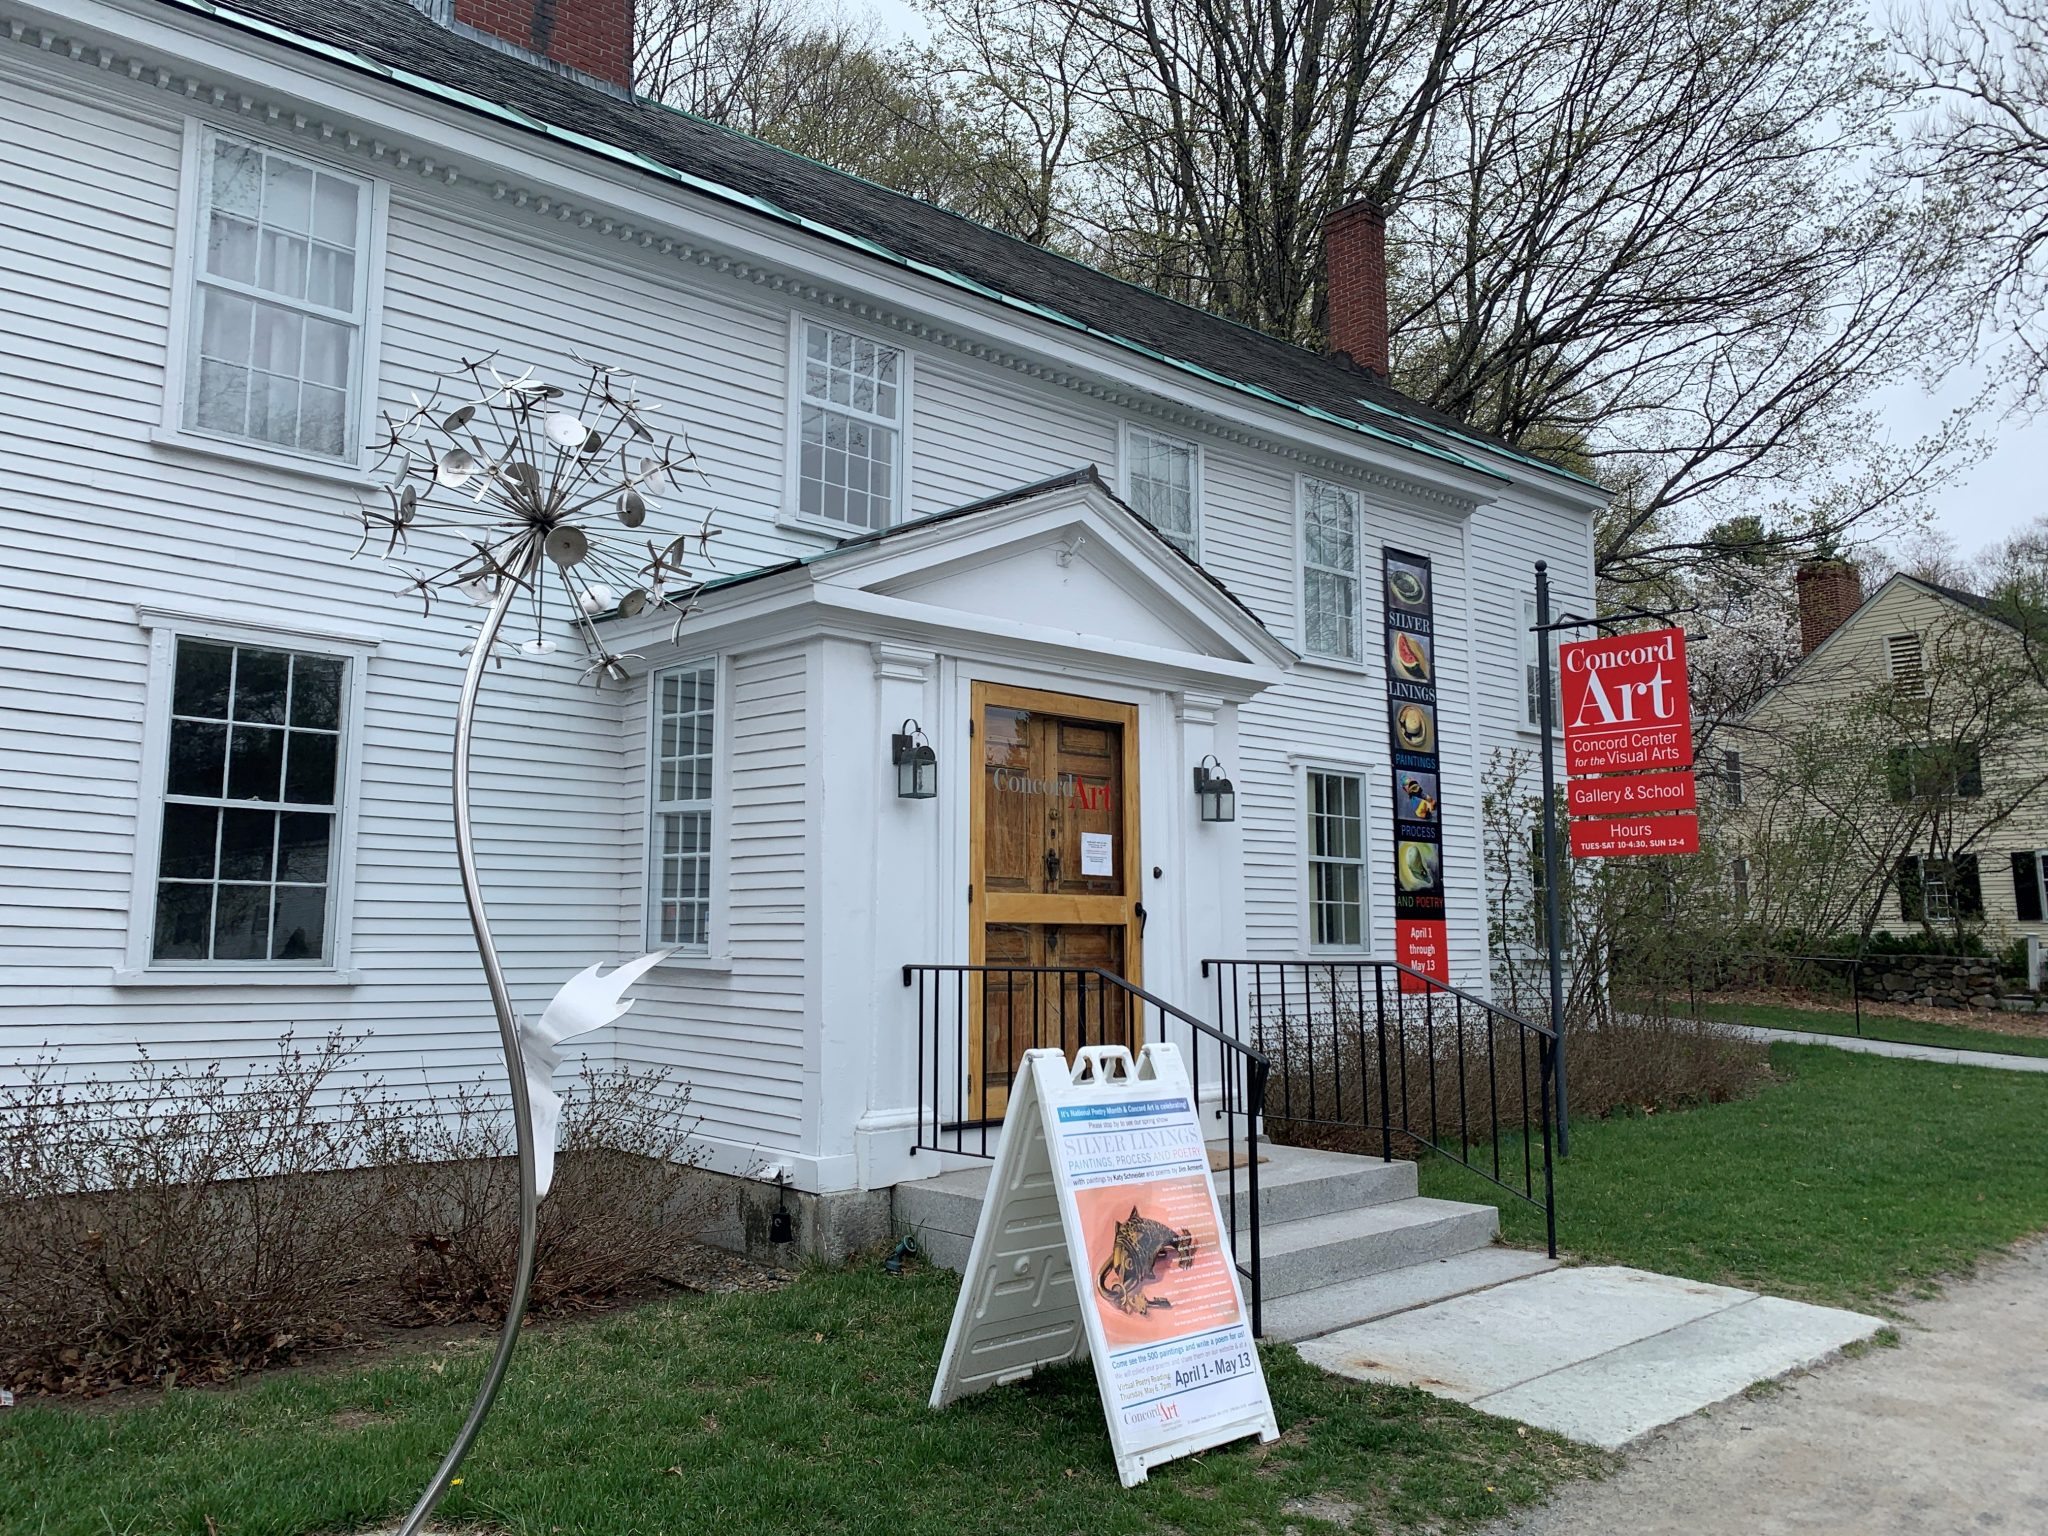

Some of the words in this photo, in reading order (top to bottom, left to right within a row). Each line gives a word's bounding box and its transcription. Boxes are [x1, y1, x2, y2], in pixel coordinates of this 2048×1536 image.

[1388, 612, 1430, 633] SILVER
[1566, 636, 1676, 672] Concord
[1388, 680, 1436, 702] LININGS
[1568, 663, 1675, 727] Art
[1573, 735, 1627, 753] Concord
[1631, 732, 1677, 747] Center
[1395, 753, 1436, 769] PAINTINGS
[1575, 758, 1588, 767] for
[1590, 756, 1606, 766] the
[1606, 748, 1648, 764] Visual
[1651, 747, 1680, 760] Arts
[1575, 789, 1621, 804] Gallery
[1624, 786, 1634, 800] &
[1637, 783, 1684, 799] School
[1401, 824, 1436, 839] PROCESS
[1610, 823, 1652, 837] Hours
[1581, 842, 1615, 850] TUES-SAT
[1618, 840, 1648, 849] 10-4:30,
[1650, 839, 1666, 847] SUN
[1668, 838, 1684, 846] 12-4
[1397, 896, 1414, 907] AND
[1416, 896, 1443, 909] POETRY
[1411, 927, 1427, 940] April
[1428, 927, 1432, 938] 1
[1409, 944, 1435, 957] through
[1411, 960, 1425, 973] May
[1427, 960, 1435, 971] 13
[1070, 1108, 1091, 1117] National
[1091, 1107, 1106, 1116] Poetry
[1106, 1106, 1122, 1114] Month
[1128, 1104, 1146, 1112] Concord
[1064, 1134, 1126, 1157] SILVER
[1129, 1127, 1198, 1150] LININGS
[1068, 1157, 1114, 1170] PAINTINGS,
[1115, 1152, 1151, 1165] PROCESS
[1153, 1150, 1171, 1161] AND
[1173, 1147, 1200, 1159] POETRY
[1123, 1172, 1145, 1180] Schneider
[1112, 1360, 1128, 1369] Come
[1128, 1358, 1137, 1366] see
[1138, 1355, 1147, 1363] the
[1147, 1351, 1158, 1361] 500
[1159, 1346, 1184, 1359] paintings
[1185, 1342, 1196, 1351] and
[1196, 1339, 1209, 1348] write
[1215, 1334, 1229, 1345] poem
[1175, 1365, 1200, 1388] April
[1202, 1363, 1208, 1378] 1
[1214, 1358, 1236, 1374] May
[1237, 1352, 1251, 1368] 13
[1118, 1380, 1135, 1391] Virtual
[1135, 1377, 1151, 1387] Poetry
[1144, 1386, 1155, 1394] May
